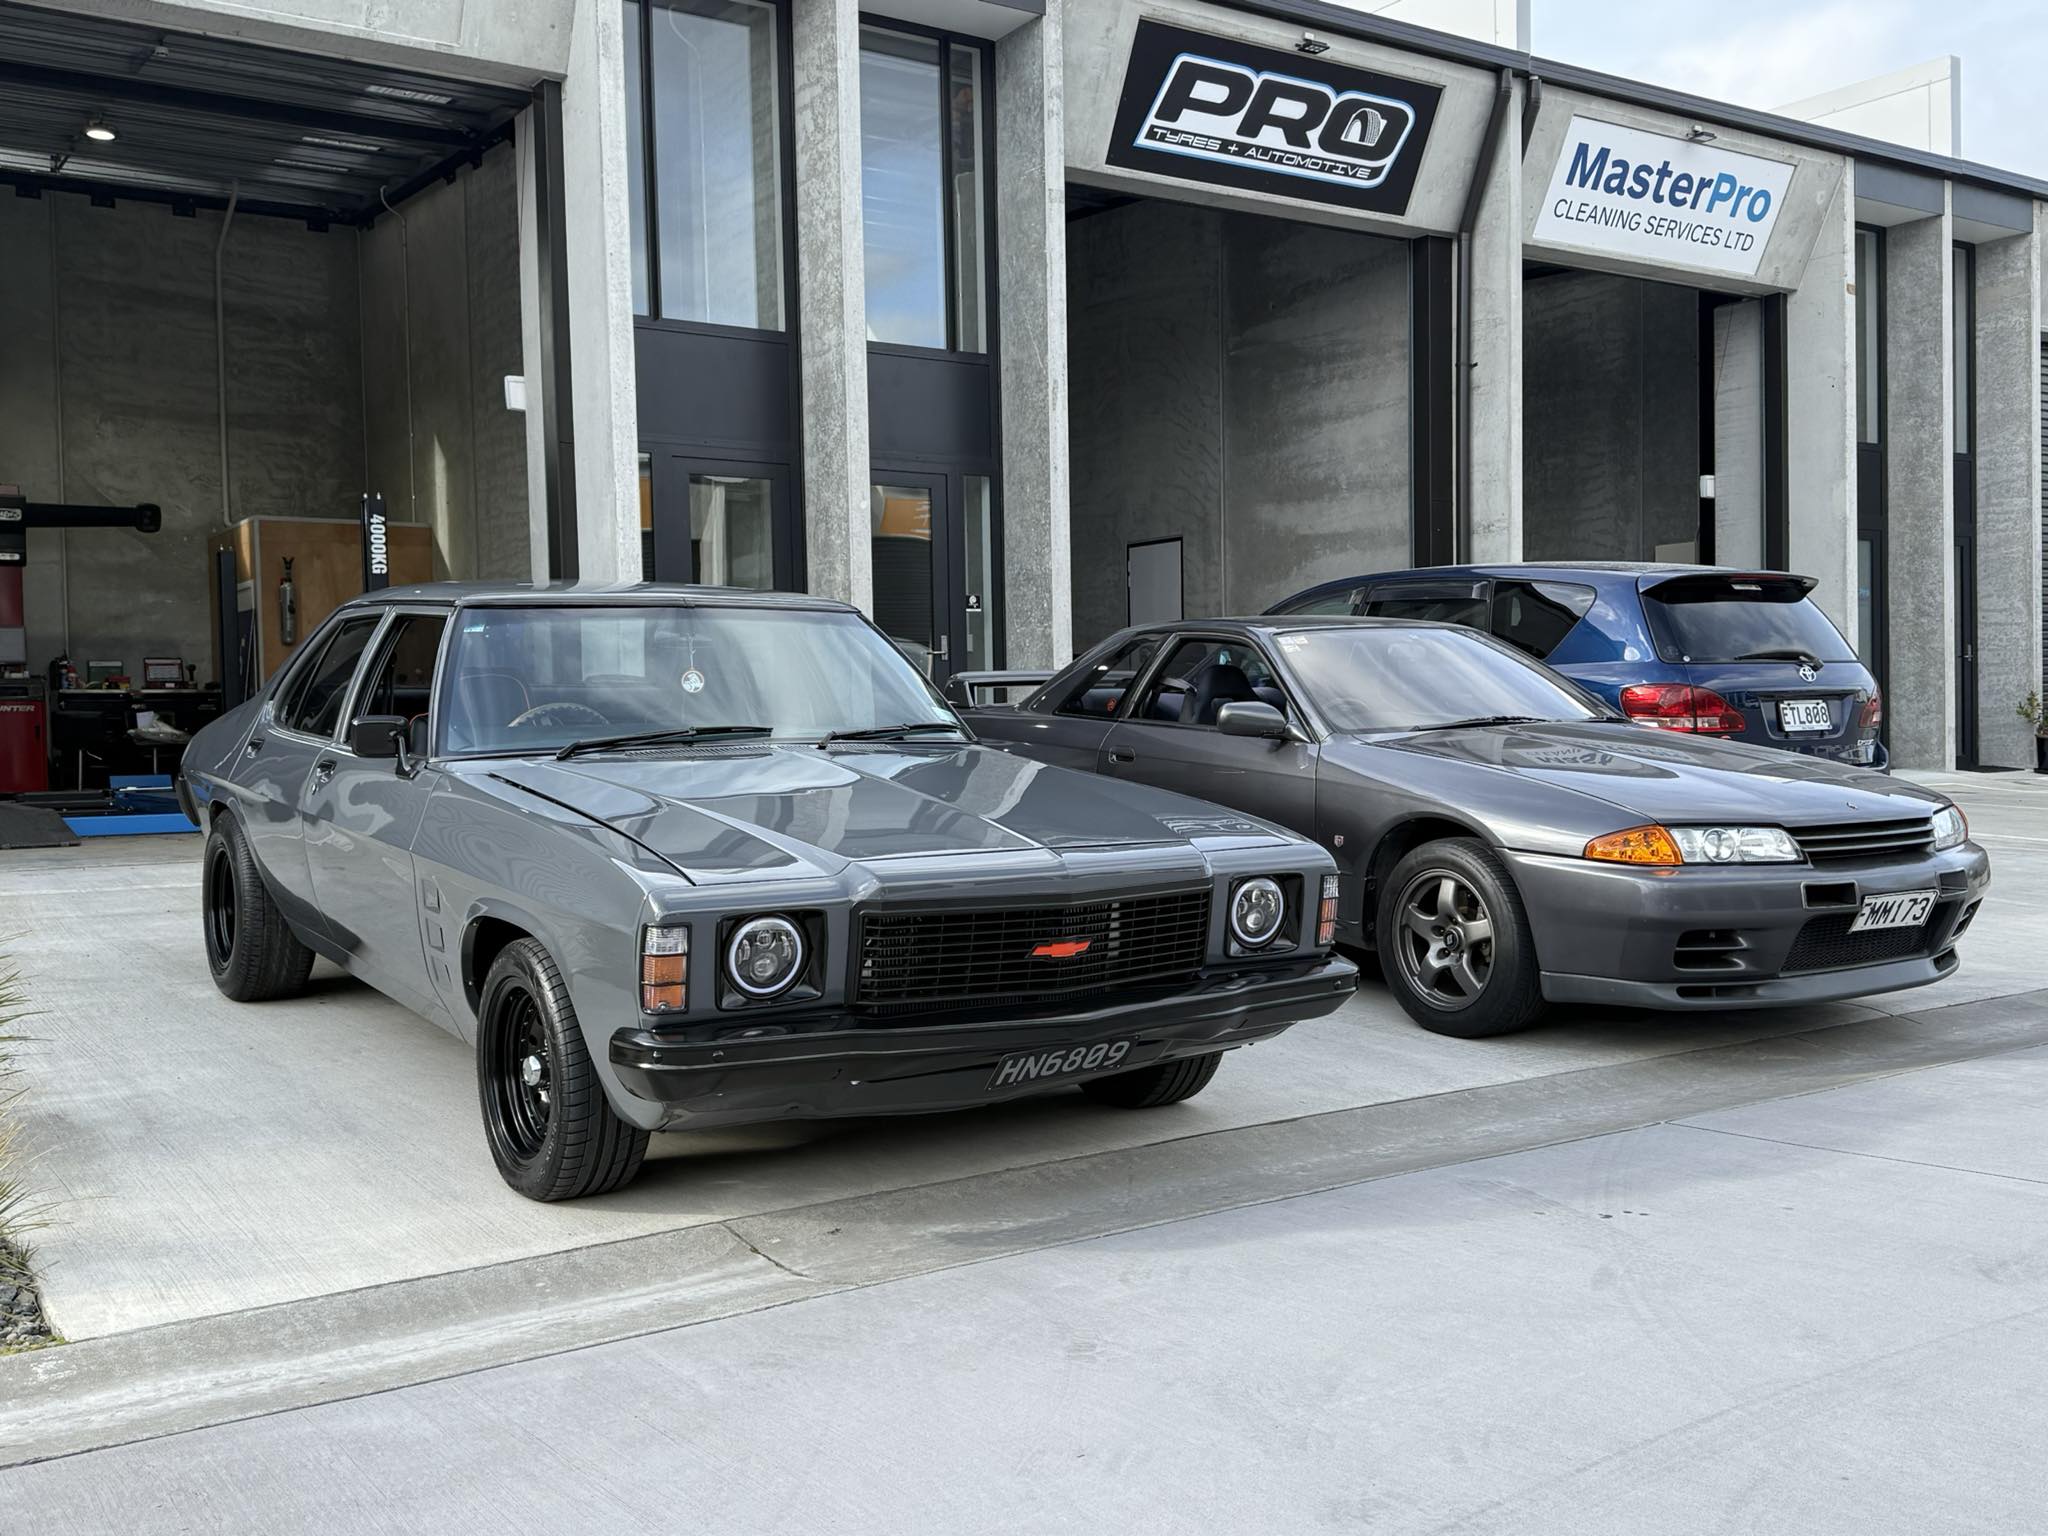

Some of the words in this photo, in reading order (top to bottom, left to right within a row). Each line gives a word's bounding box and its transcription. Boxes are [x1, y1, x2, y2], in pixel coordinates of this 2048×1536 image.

[1153, 60, 1410, 161] PRO
[1152, 127, 1221, 151] TYRES
[1228, 143, 1239, 154] +
[1244, 146, 1372, 180] AUTOMOTIVE
[1565, 142, 1772, 223] MasterPro
[1553, 198, 1642, 232] CLEANING
[1643, 215, 1722, 247] SERVICES
[1724, 231, 1755, 252] LTD
[370, 514, 388, 575] 4000KG
[1781, 706, 1829, 725] ETL808
[995, 1040, 1130, 1086] HN6809
